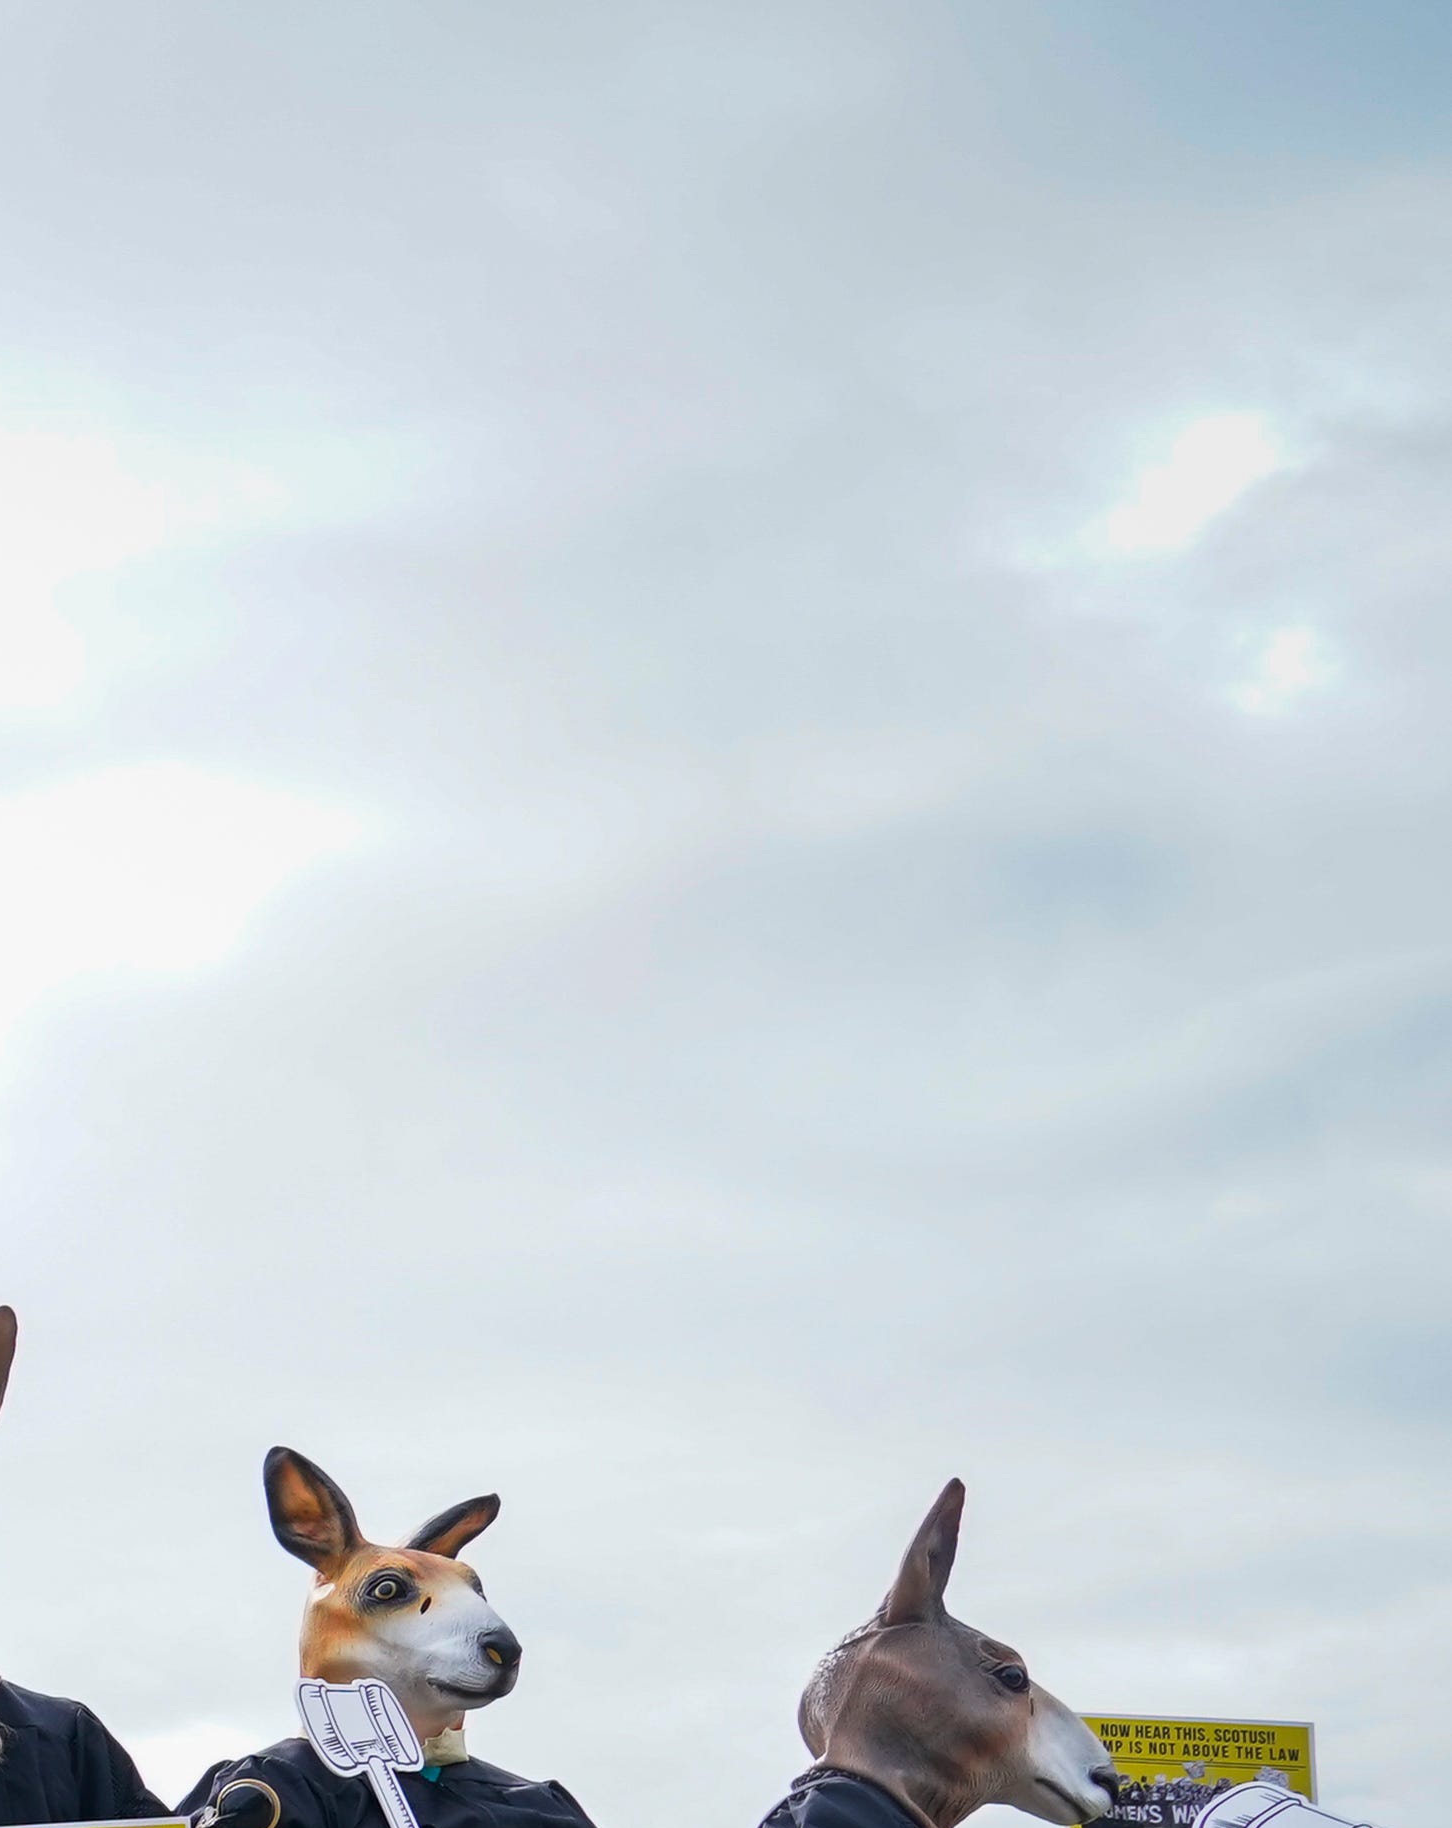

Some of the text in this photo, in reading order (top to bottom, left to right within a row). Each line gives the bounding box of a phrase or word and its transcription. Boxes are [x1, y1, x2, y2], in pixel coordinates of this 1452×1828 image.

[1101, 1724, 1274, 1744] NOW HEAR THIS, SCOTUS!!
[1130, 1741, 1142, 1754] IS
[1149, 1742, 1175, 1755] NOT
[1183, 1744, 1228, 1758] ABOVE
[1235, 1746, 1262, 1760] THE
[1270, 1748, 1299, 1761] LAW
